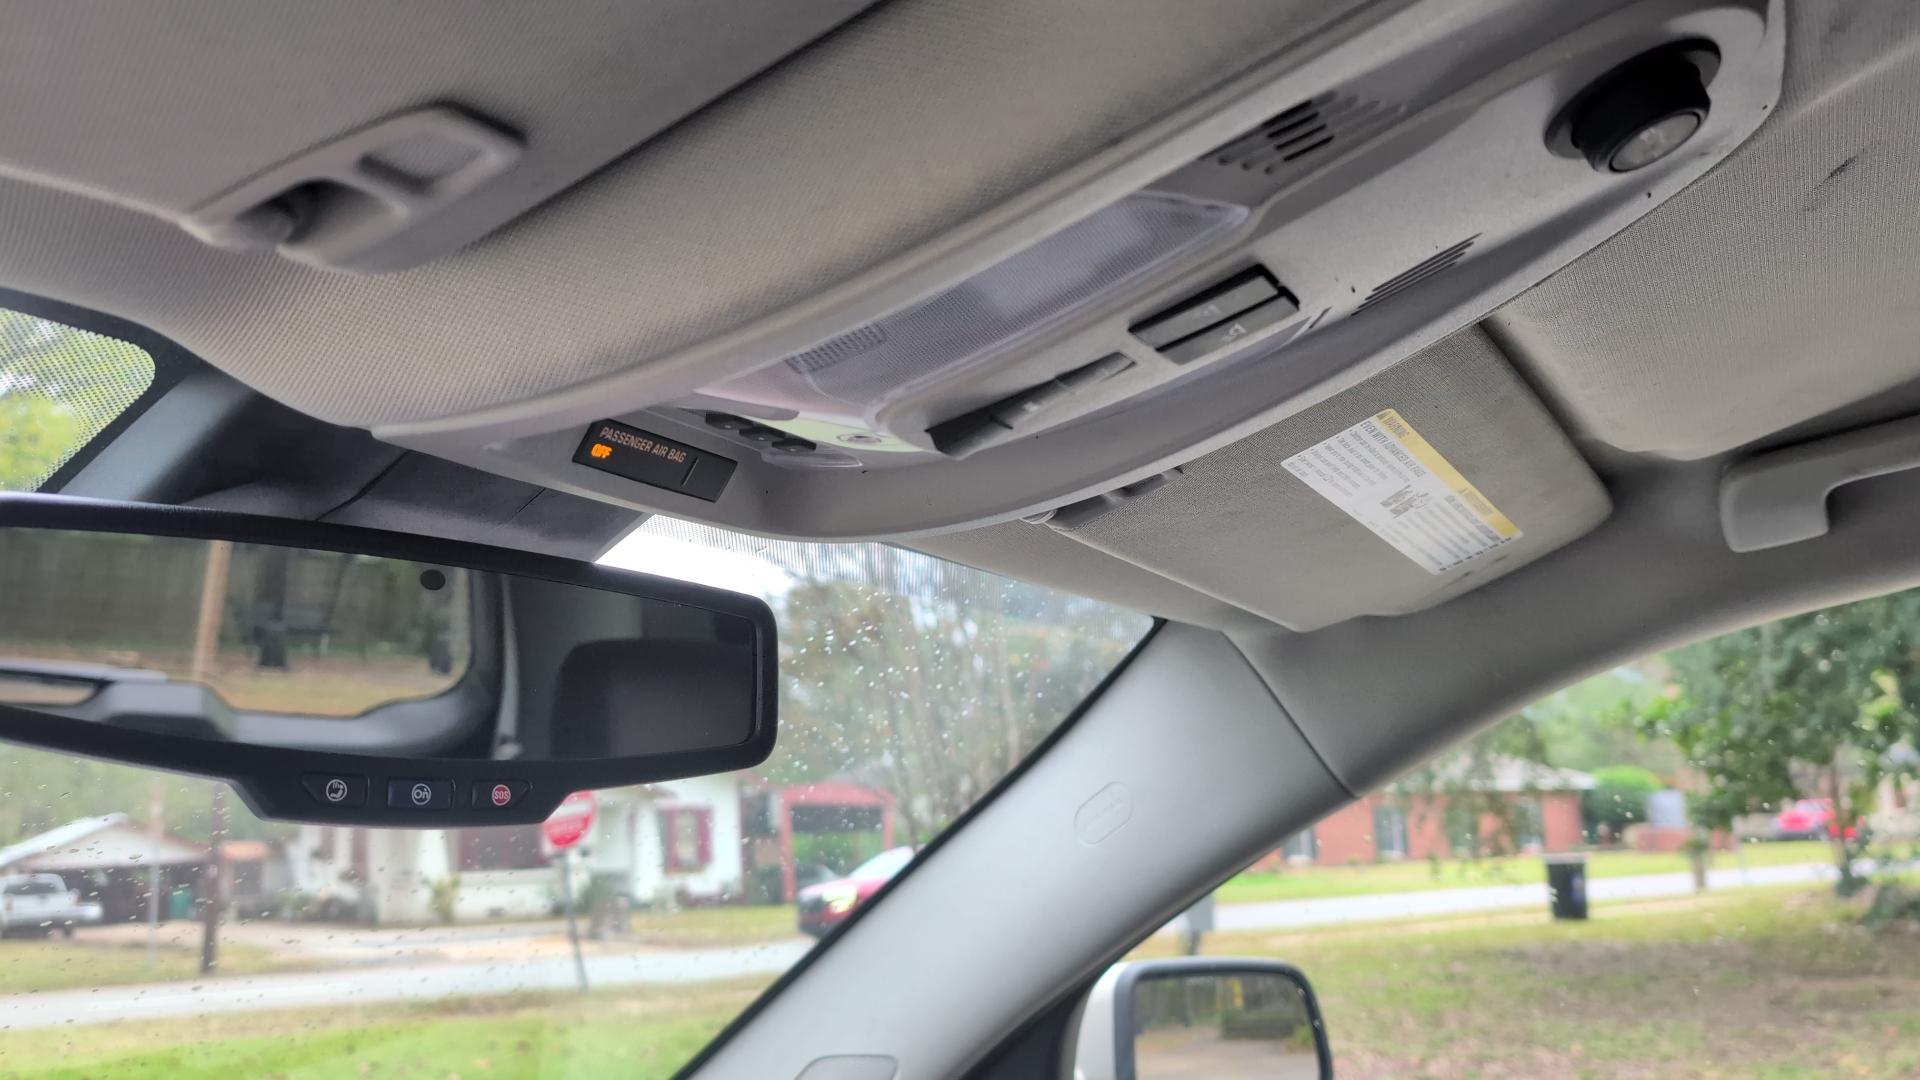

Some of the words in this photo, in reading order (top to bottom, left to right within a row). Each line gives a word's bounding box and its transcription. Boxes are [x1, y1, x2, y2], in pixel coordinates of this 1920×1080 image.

[1360, 420, 1379, 434] EVEN
[1372, 430, 1389, 445] WITH
[1383, 416, 1410, 439] WARNING
[590, 443, 613, 459] OFF
[599, 427, 653, 452] PASSENGER
[652, 443, 668, 458] AIR
[667, 449, 687, 463] BAG
[494, 790, 509, 801] SOS
